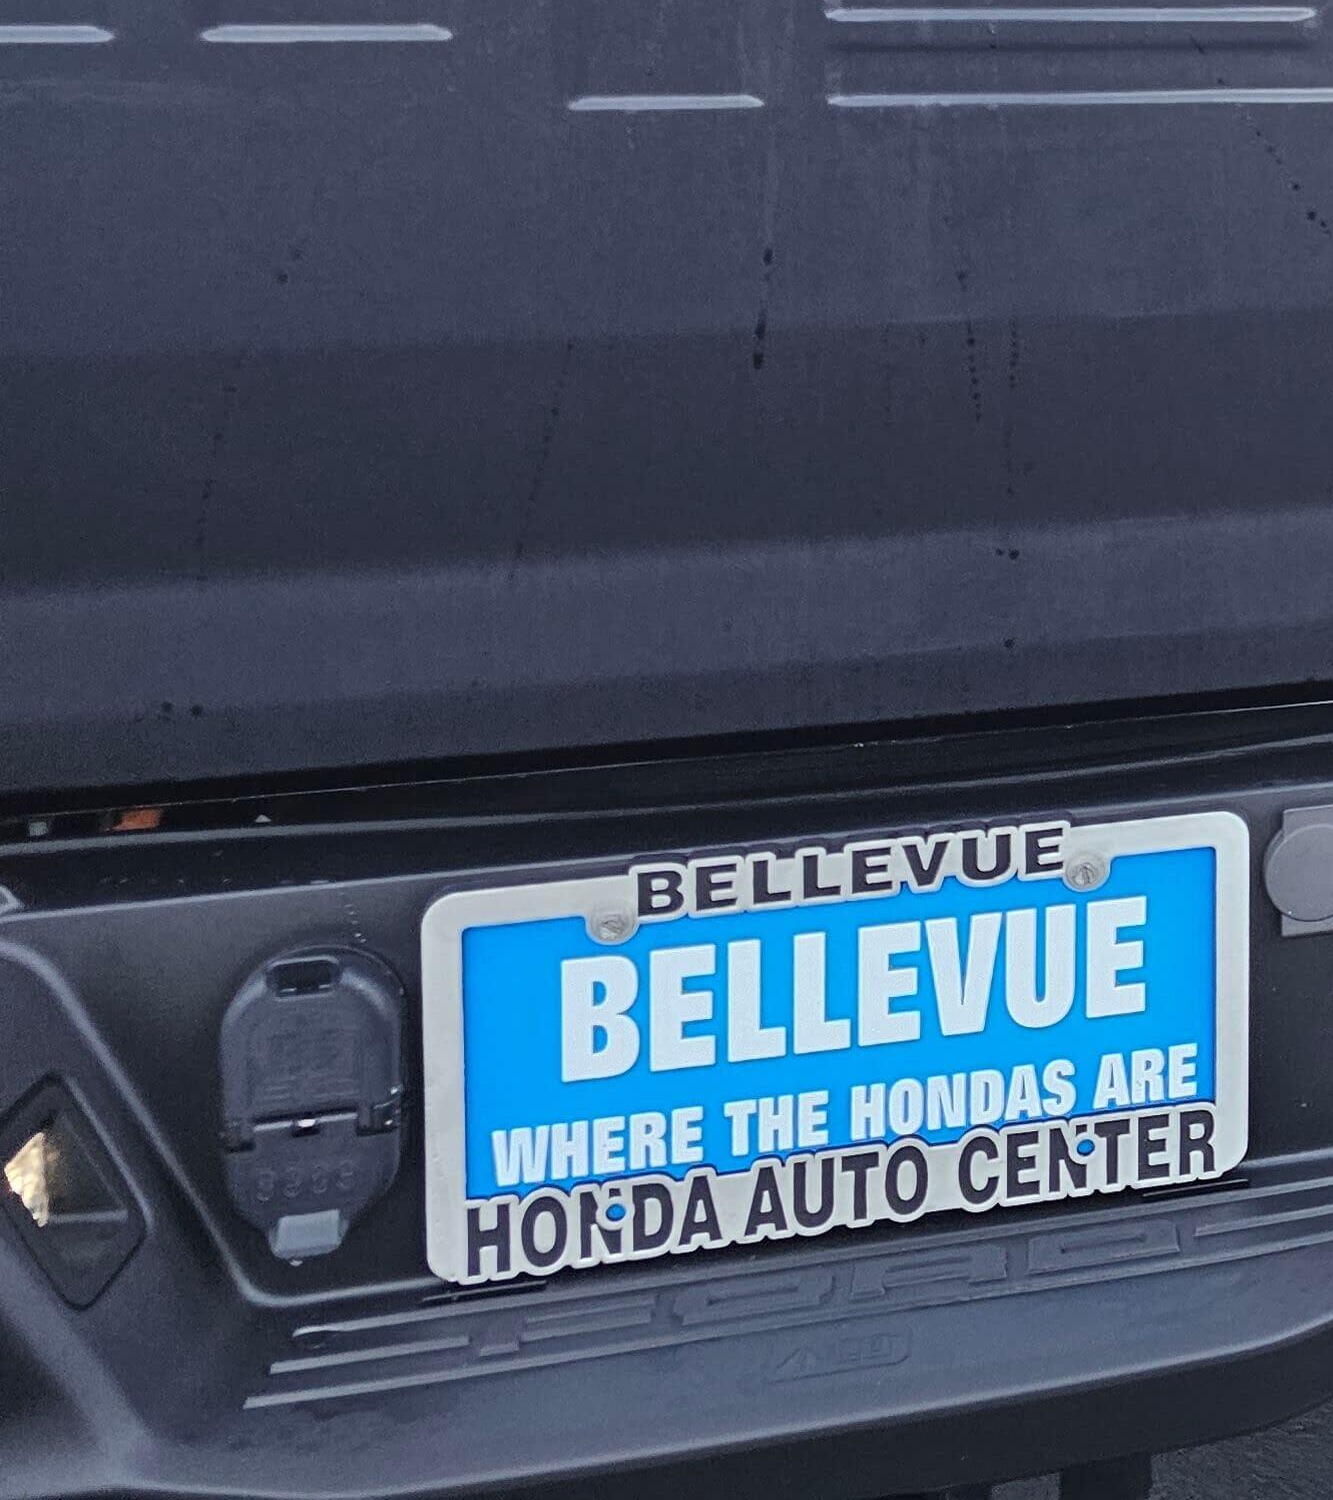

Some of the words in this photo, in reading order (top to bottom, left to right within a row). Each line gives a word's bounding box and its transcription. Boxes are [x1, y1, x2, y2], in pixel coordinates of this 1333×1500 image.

[637, 824, 1067, 917] BELLEVUE
[561, 896, 1149, 1083] BELLEVUE
[491, 1105, 704, 1187] WHERE
[724, 1093, 829, 1157] THE
[850, 1060, 1076, 1142] HONDAS
[1095, 1042, 1199, 1108] ARE
[466, 1176, 722, 1277] HONDA
[745, 1147, 931, 1239] AUTO
[959, 1109, 1217, 1206] CENTER
